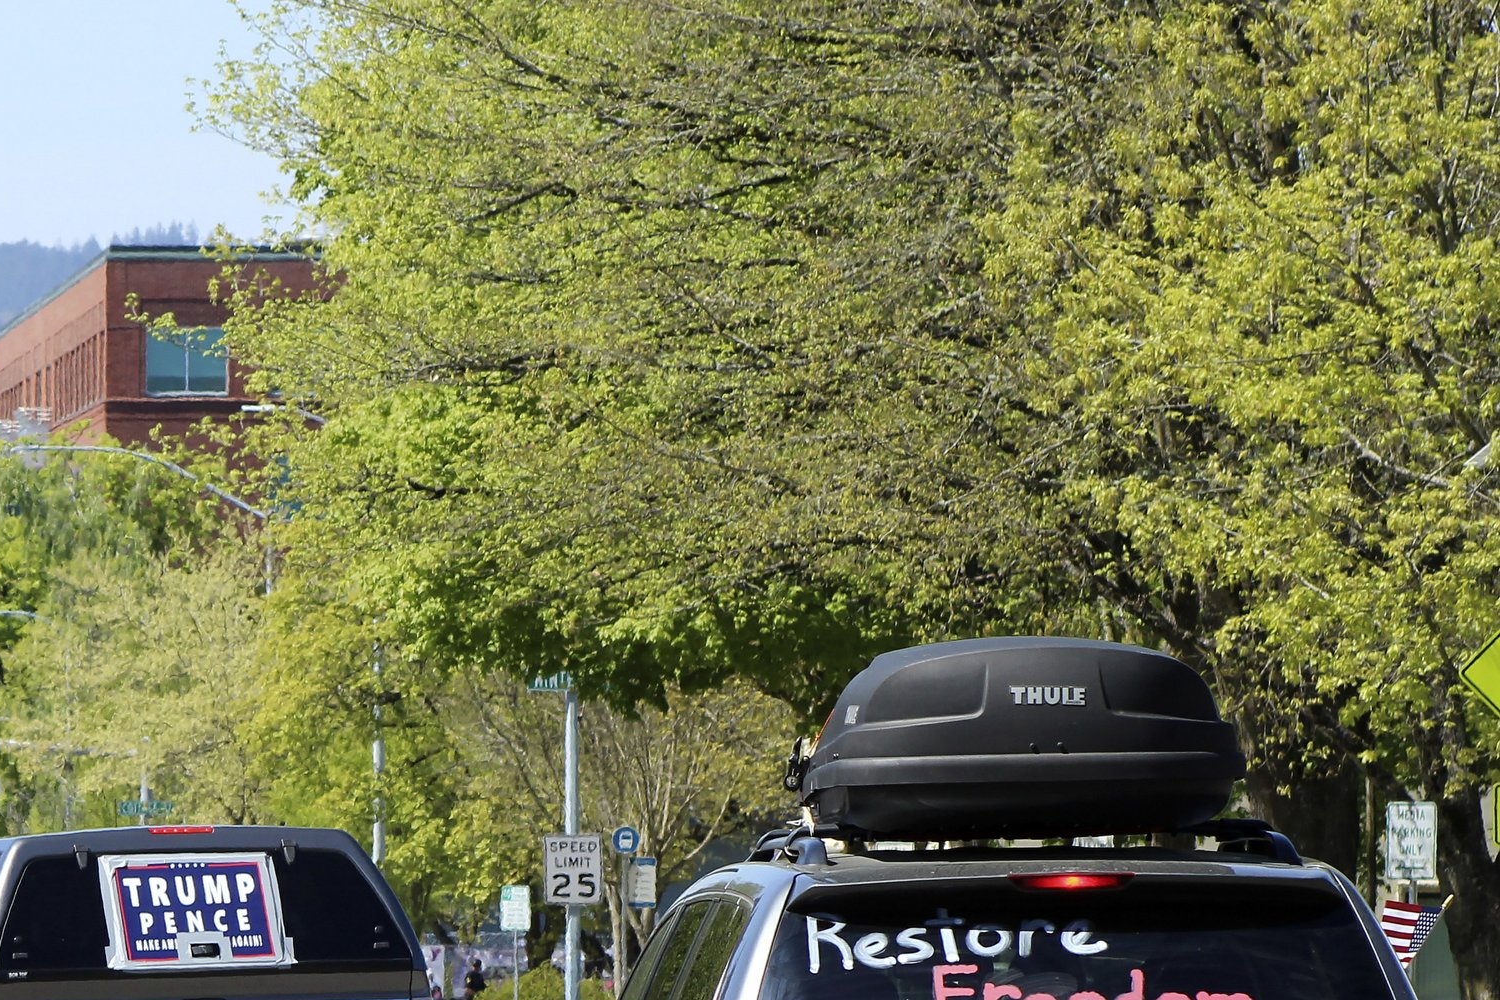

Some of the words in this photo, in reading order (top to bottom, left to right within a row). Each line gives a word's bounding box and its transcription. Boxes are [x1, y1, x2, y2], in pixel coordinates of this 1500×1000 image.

[1010, 686, 1086, 706] THULE
[1397, 808, 1426, 821] MEDIA
[1391, 826, 1432, 839] PARKING
[550, 841, 598, 853] SPEED
[1400, 844, 1423, 856] ONLY
[554, 856, 592, 868] LIMIT
[122, 873, 255, 908] TRUMP
[552, 873, 596, 898] 25
[139, 908, 251, 935] PENCE
[135, 938, 161, 951] MAKE
[232, 934, 263, 948] AGAIN!
[806, 908, 1108, 974] Restore
